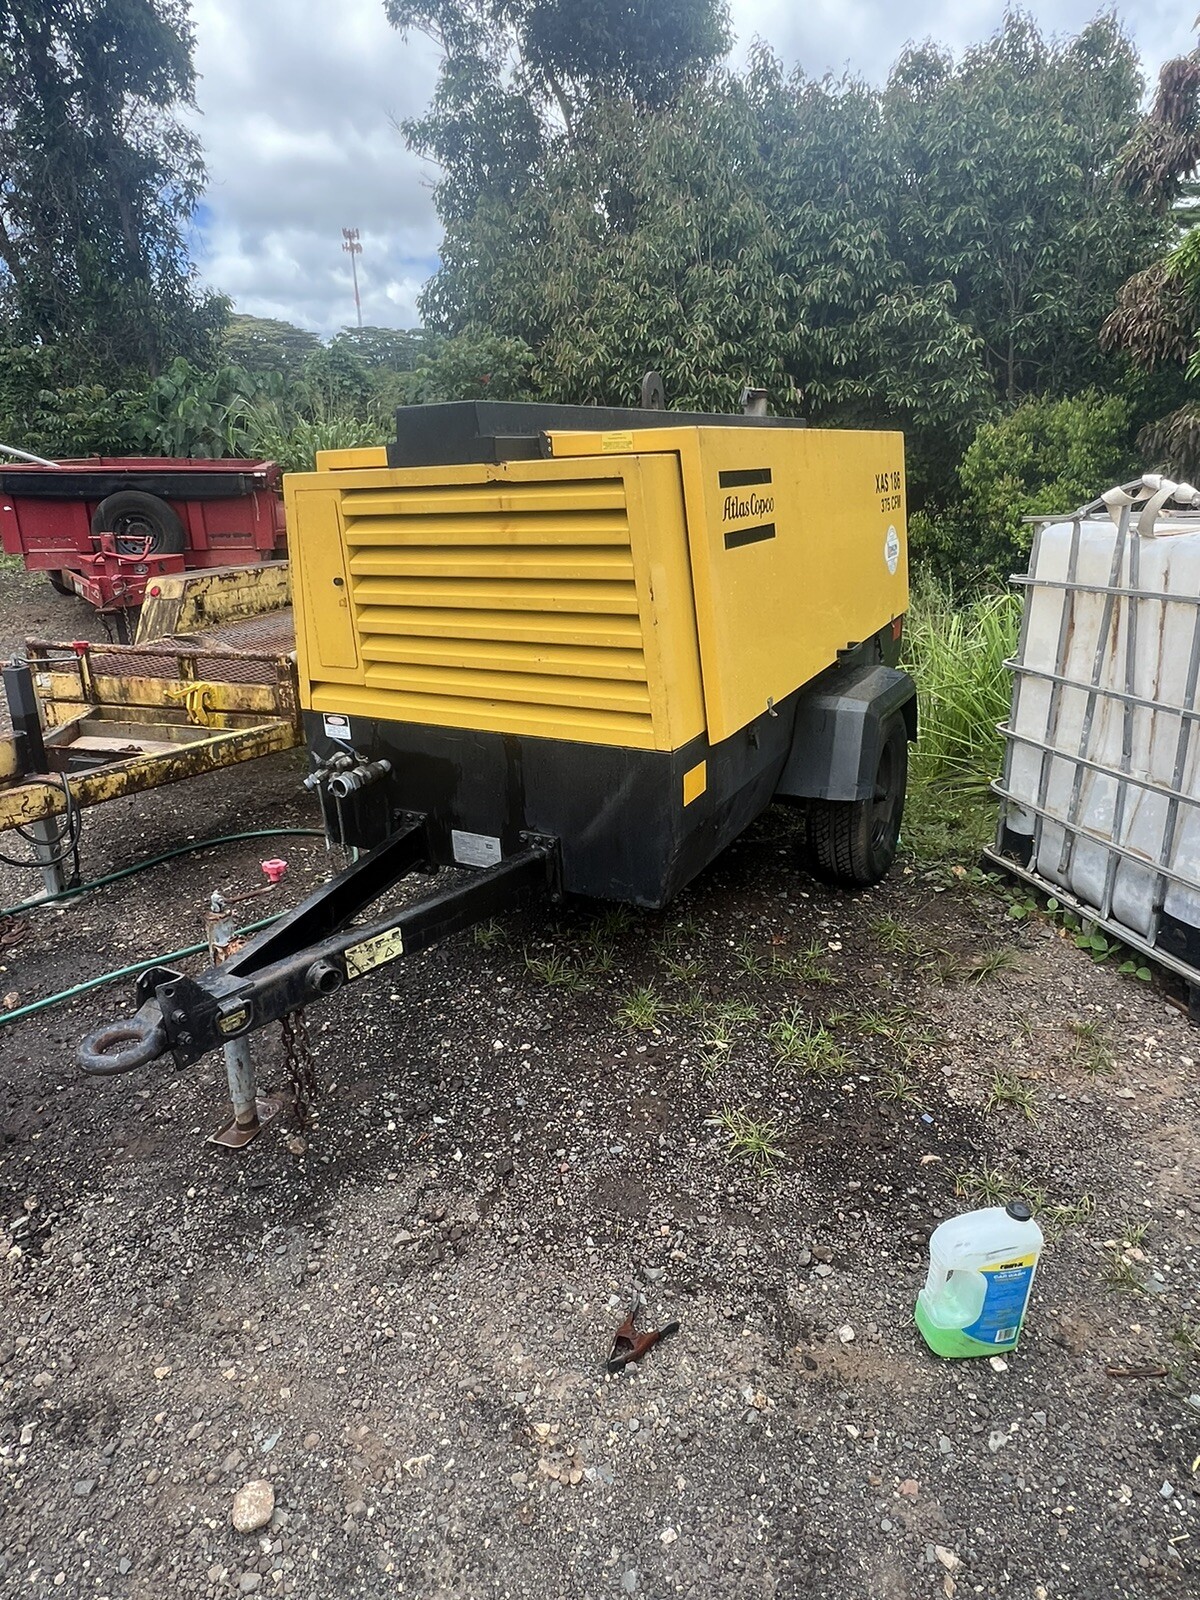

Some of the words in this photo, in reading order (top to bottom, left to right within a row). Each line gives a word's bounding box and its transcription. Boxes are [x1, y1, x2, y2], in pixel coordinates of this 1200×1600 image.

[875, 472, 889, 493] XAS
[890, 471, 900, 490] 186
[722, 496, 750, 522] Atlas
[750, 492, 774, 519] Copco
[881, 498, 890, 513] 375
[891, 494, 901, 510] CFM
